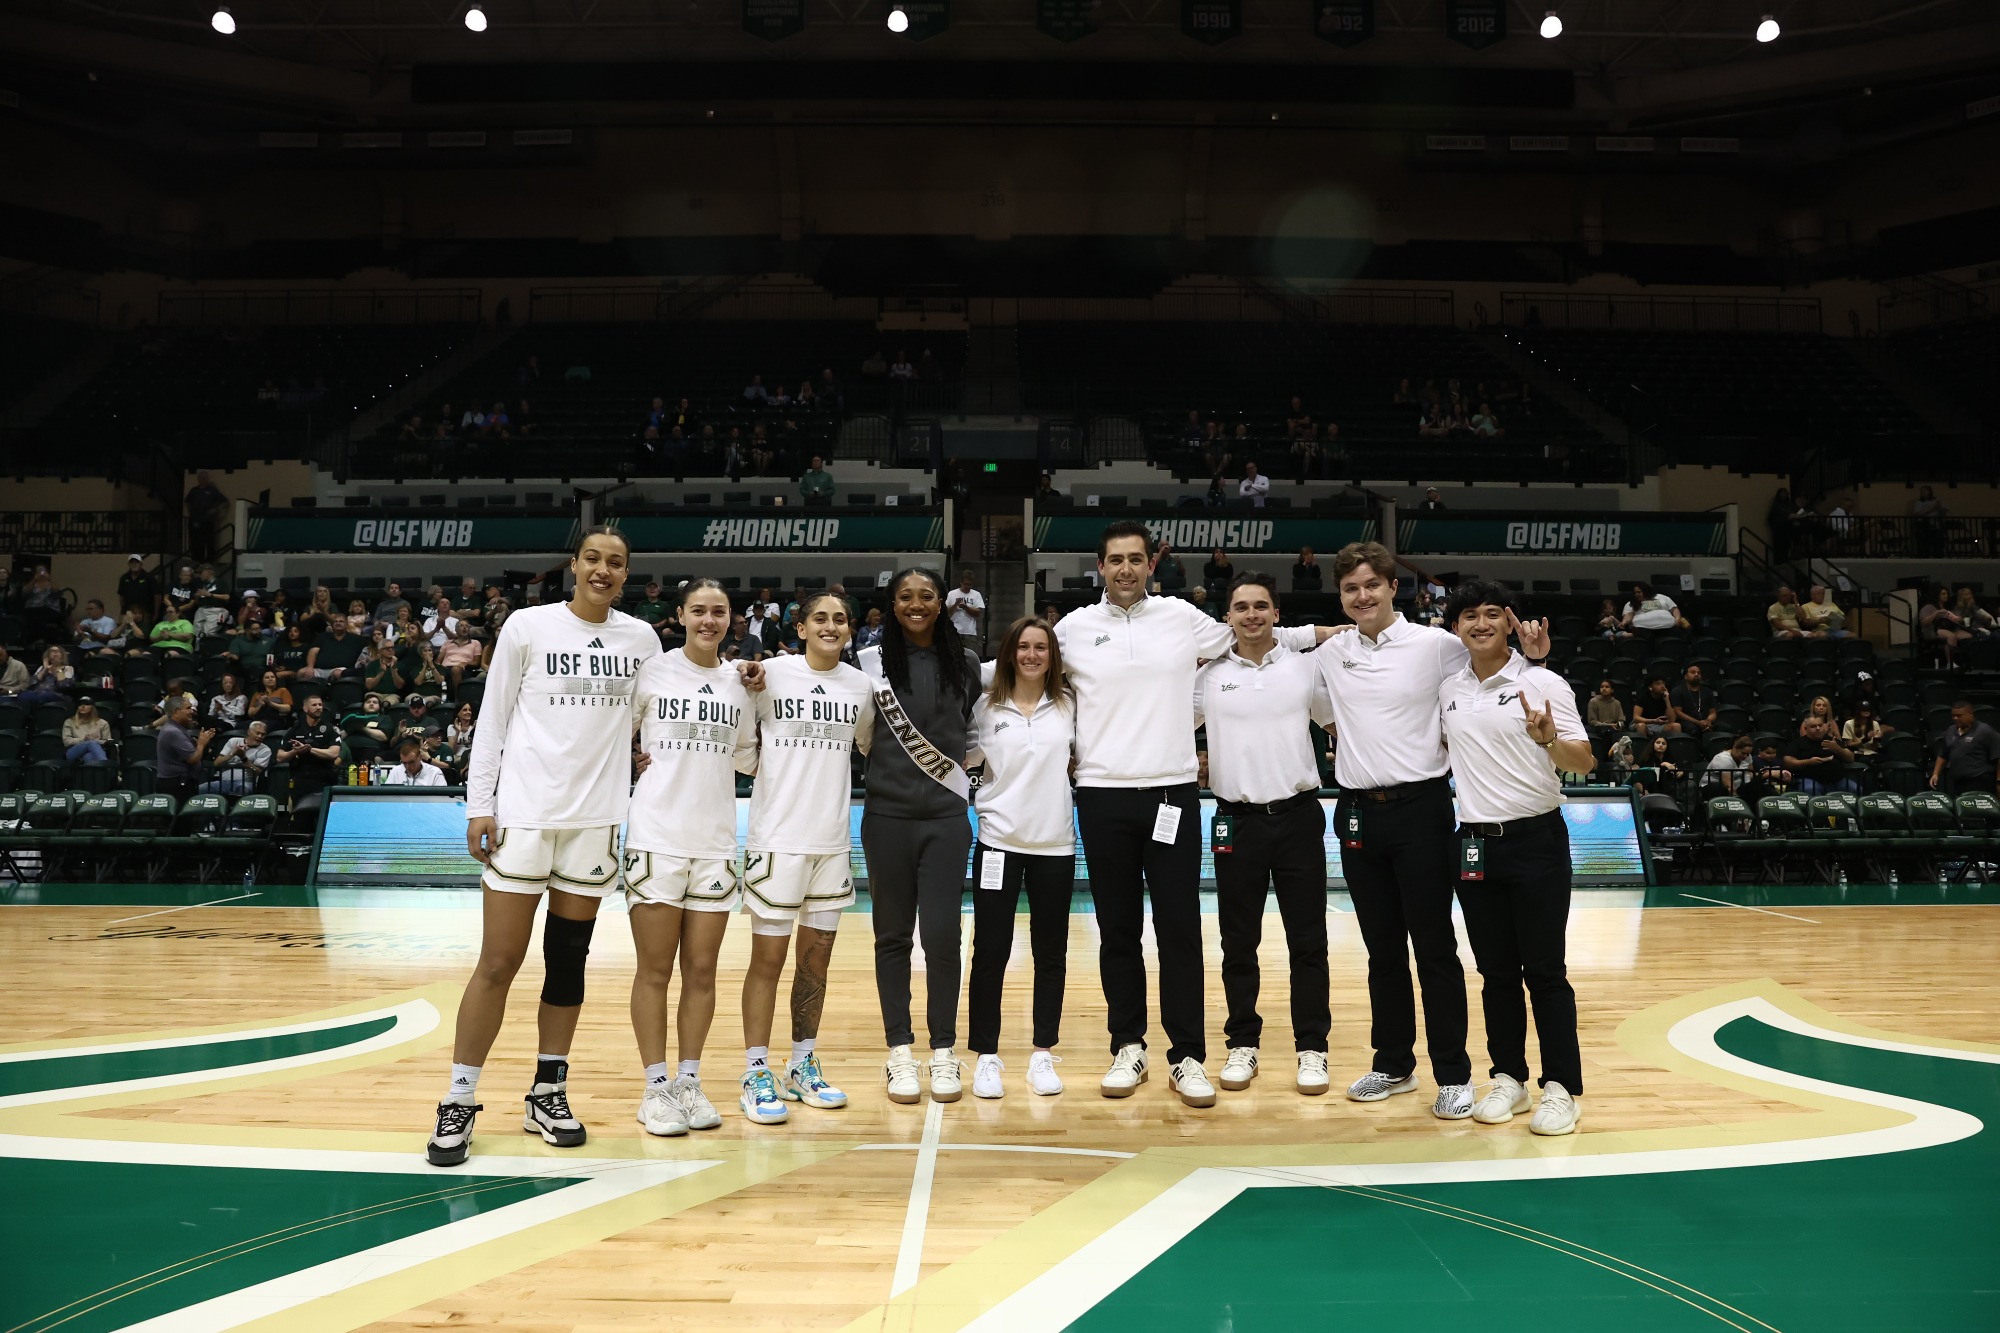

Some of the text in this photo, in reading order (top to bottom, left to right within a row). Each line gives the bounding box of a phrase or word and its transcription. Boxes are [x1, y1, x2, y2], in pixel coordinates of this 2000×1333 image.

[1191, 12, 1231, 28] 1990
[1457, 17, 1496, 33] 2012
[353, 519, 474, 548] @USFWBB
[702, 518, 841, 548] #HORNSUP
[1505, 521, 1622, 551] @USFMBB
[546, 653, 640, 678] USF BULLS
[550, 696, 629, 707] BASKETBAL
[658, 698, 741, 729] USF BULLS
[773, 698, 859, 725] USF BULLS
[874, 689, 956, 781] SENIOR
